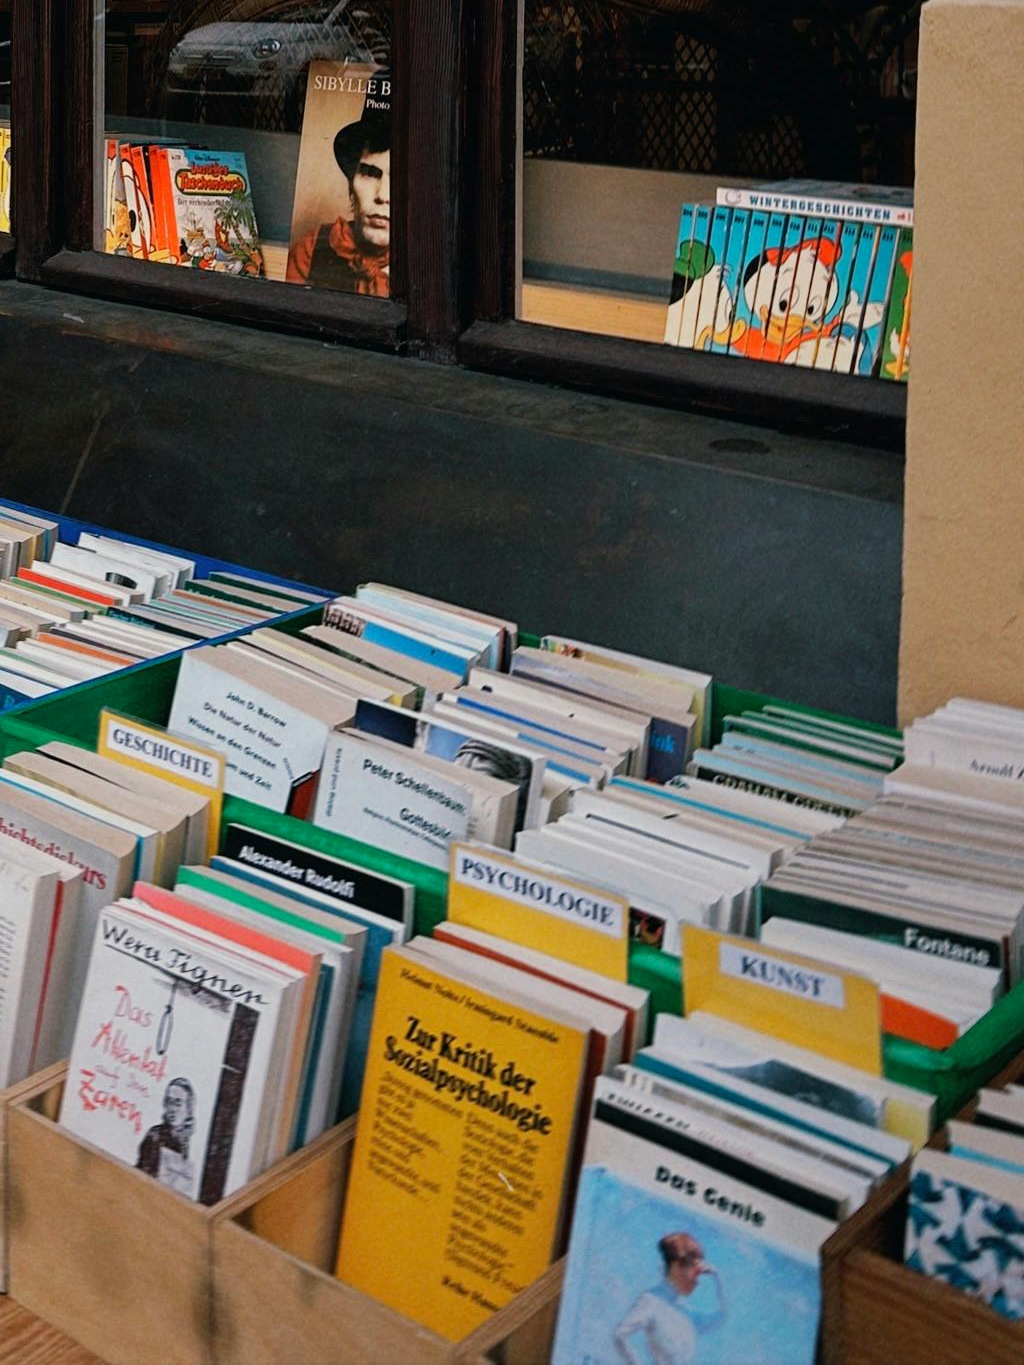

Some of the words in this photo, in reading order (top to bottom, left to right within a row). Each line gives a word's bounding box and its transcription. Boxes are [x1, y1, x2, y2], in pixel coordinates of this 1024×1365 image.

[314, 75, 376, 96] SIBYLLE
[749, 194, 891, 221] WINTERGESCHICHTEN
[112, 728, 214, 778] GESCHICHTE
[362, 758, 395, 781] Peter
[239, 845, 305, 880] Alexander
[461, 857, 615, 928] PSYCHOLOGIE
[904, 926, 992, 967] Fontane
[740, 955, 827, 998] KUNST
[404, 1015, 438, 1051] Zur
[439, 1031, 497, 1081] Kritik
[499, 1061, 537, 1096] der
[383, 1034, 554, 1135] Sozialpsychologie
[654, 1164, 698, 1197] Das
[702, 1187, 767, 1228] Genie
